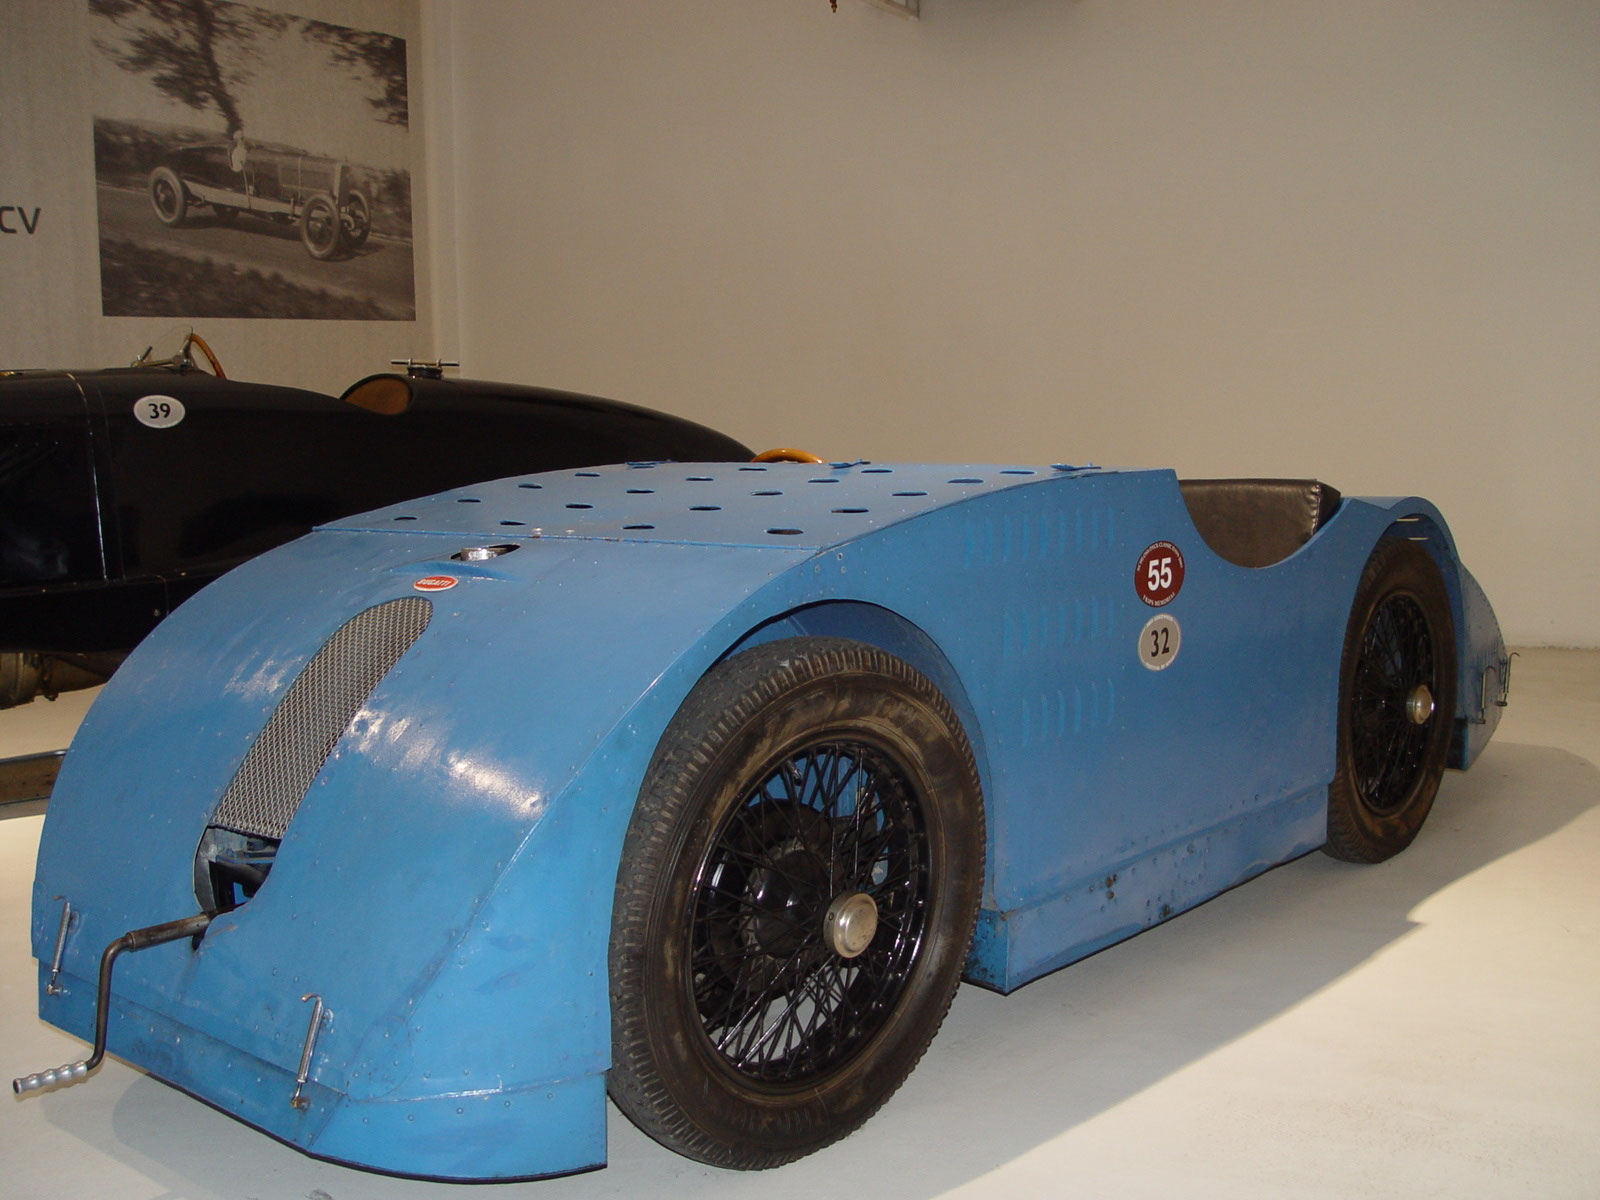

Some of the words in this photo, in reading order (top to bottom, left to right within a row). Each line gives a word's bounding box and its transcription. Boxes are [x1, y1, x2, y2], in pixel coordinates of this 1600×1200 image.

[148, 402, 171, 419] 39
[1147, 556, 1172, 591] 55
[1150, 626, 1170, 657] 32
